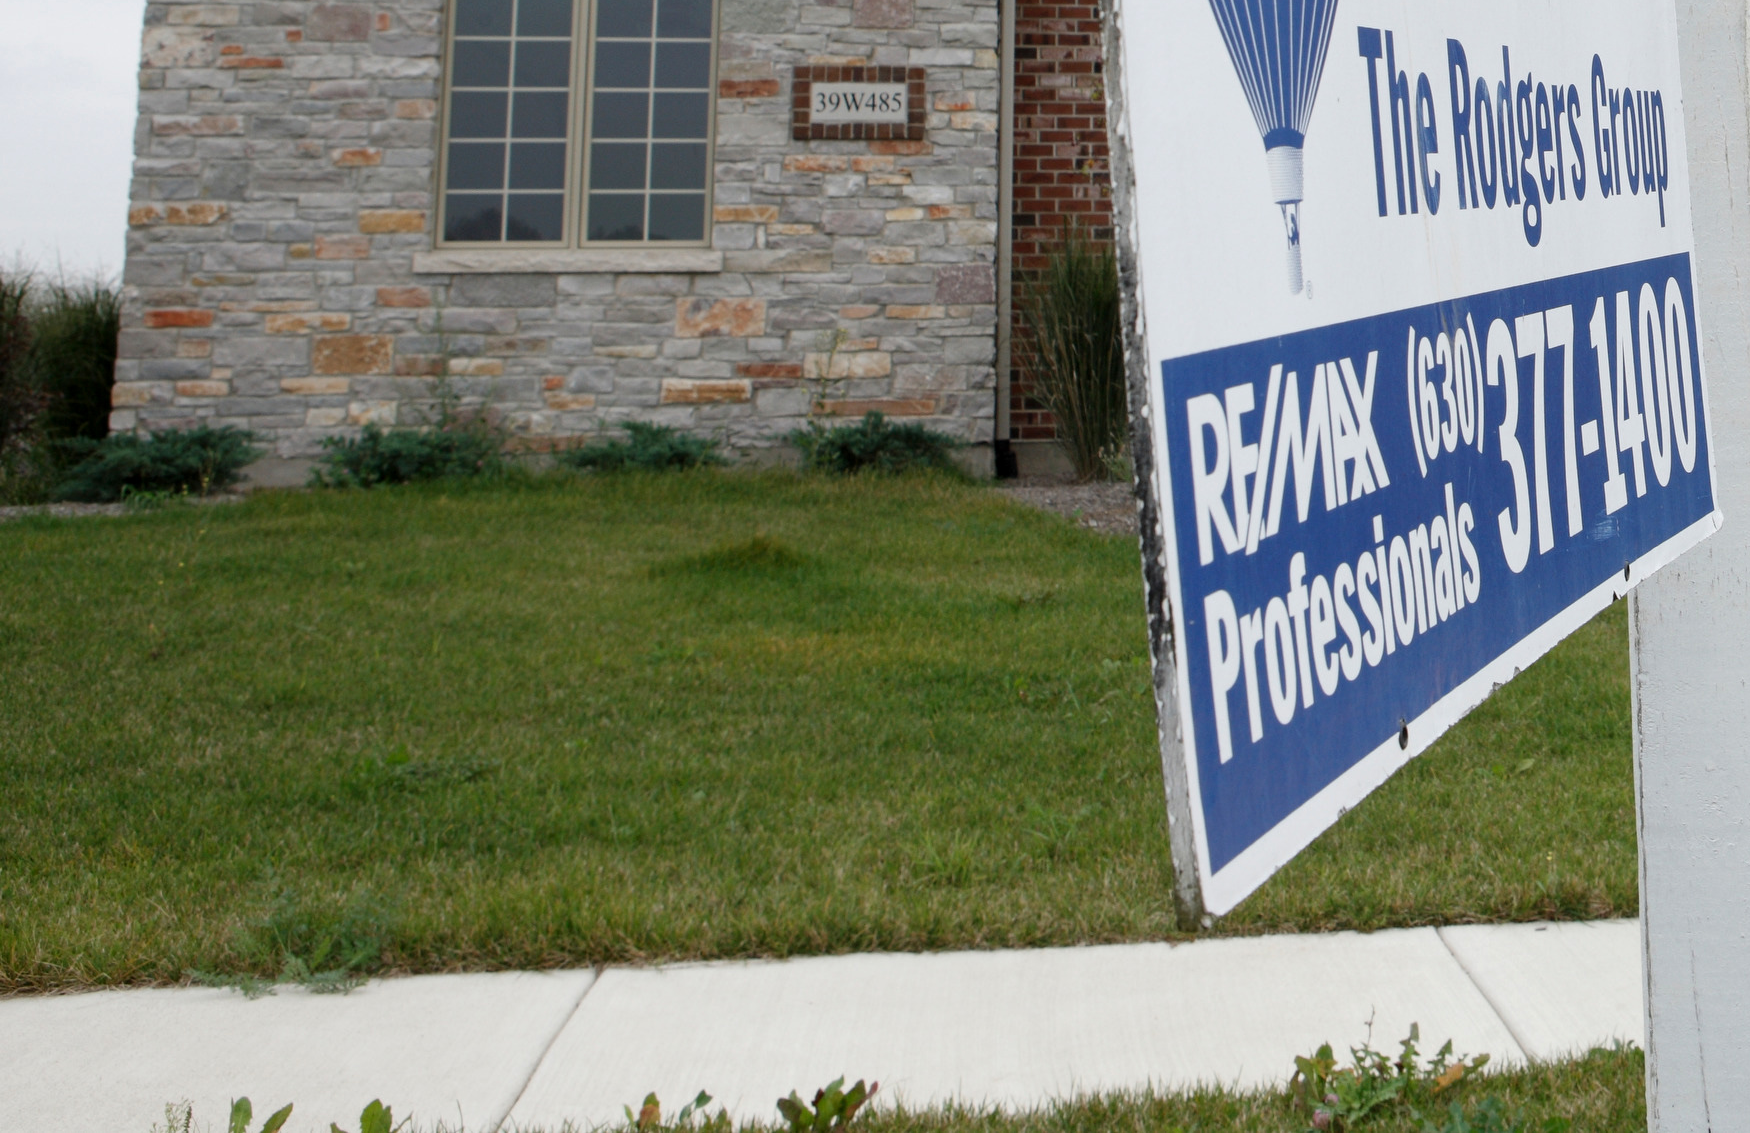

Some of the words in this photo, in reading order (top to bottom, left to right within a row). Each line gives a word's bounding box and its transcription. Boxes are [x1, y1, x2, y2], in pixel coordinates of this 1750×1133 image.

[815, 92, 902, 112] 39W485
[1357, 26, 1441, 217] The
[1446, 37, 1586, 247] Rodgers
[1591, 53, 1668, 227] Group
[1187, 351, 1390, 566] RE/MAX
[1407, 312, 1485, 478] (630)
[1486, 276, 1697, 573] 377-1400
[1204, 482, 1480, 764] Professionals
